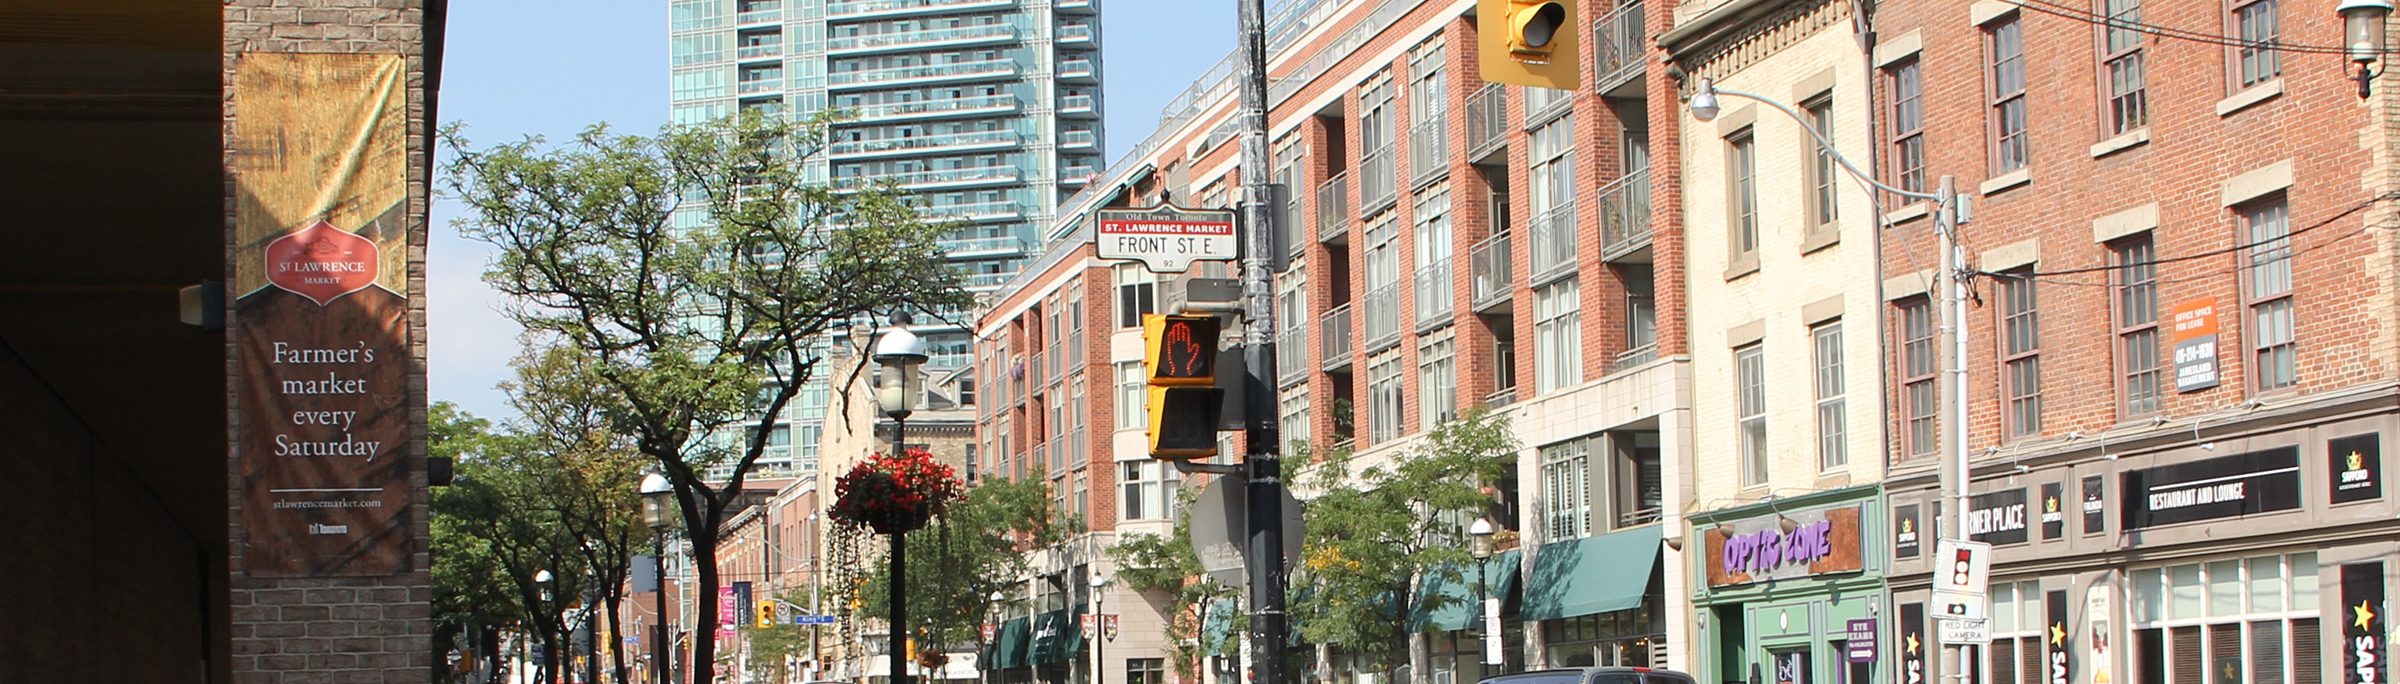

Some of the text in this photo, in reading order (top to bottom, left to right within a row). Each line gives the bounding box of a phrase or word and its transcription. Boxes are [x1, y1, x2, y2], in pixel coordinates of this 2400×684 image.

[1126, 213, 1207, 221] Old Town Toronto
[1105, 223, 1228, 234] ST. LAWRENCE MARKET
[1119, 236, 1217, 255] FRONT ST. E.
[295, 261, 366, 273] LAWRENCE
[1163, 260, 1174, 268] 92
[303, 277, 341, 285] MARKET
[273, 340, 375, 364] Farmer's
[282, 371, 368, 394] market
[293, 410, 357, 432] every
[274, 433, 381, 463] Saturday
[2149, 482, 2245, 511] RESTAURANT AND LOUNGE
[272, 498, 382, 510] stlawrencemarket.com
[1992, 503, 2025, 532] PLACE
[1724, 520, 1831, 574] OPTIC ZONE
[1852, 622, 1868, 632] EYE
[1945, 621, 1961, 630] RED
[1949, 631, 1983, 640] CAMERA
